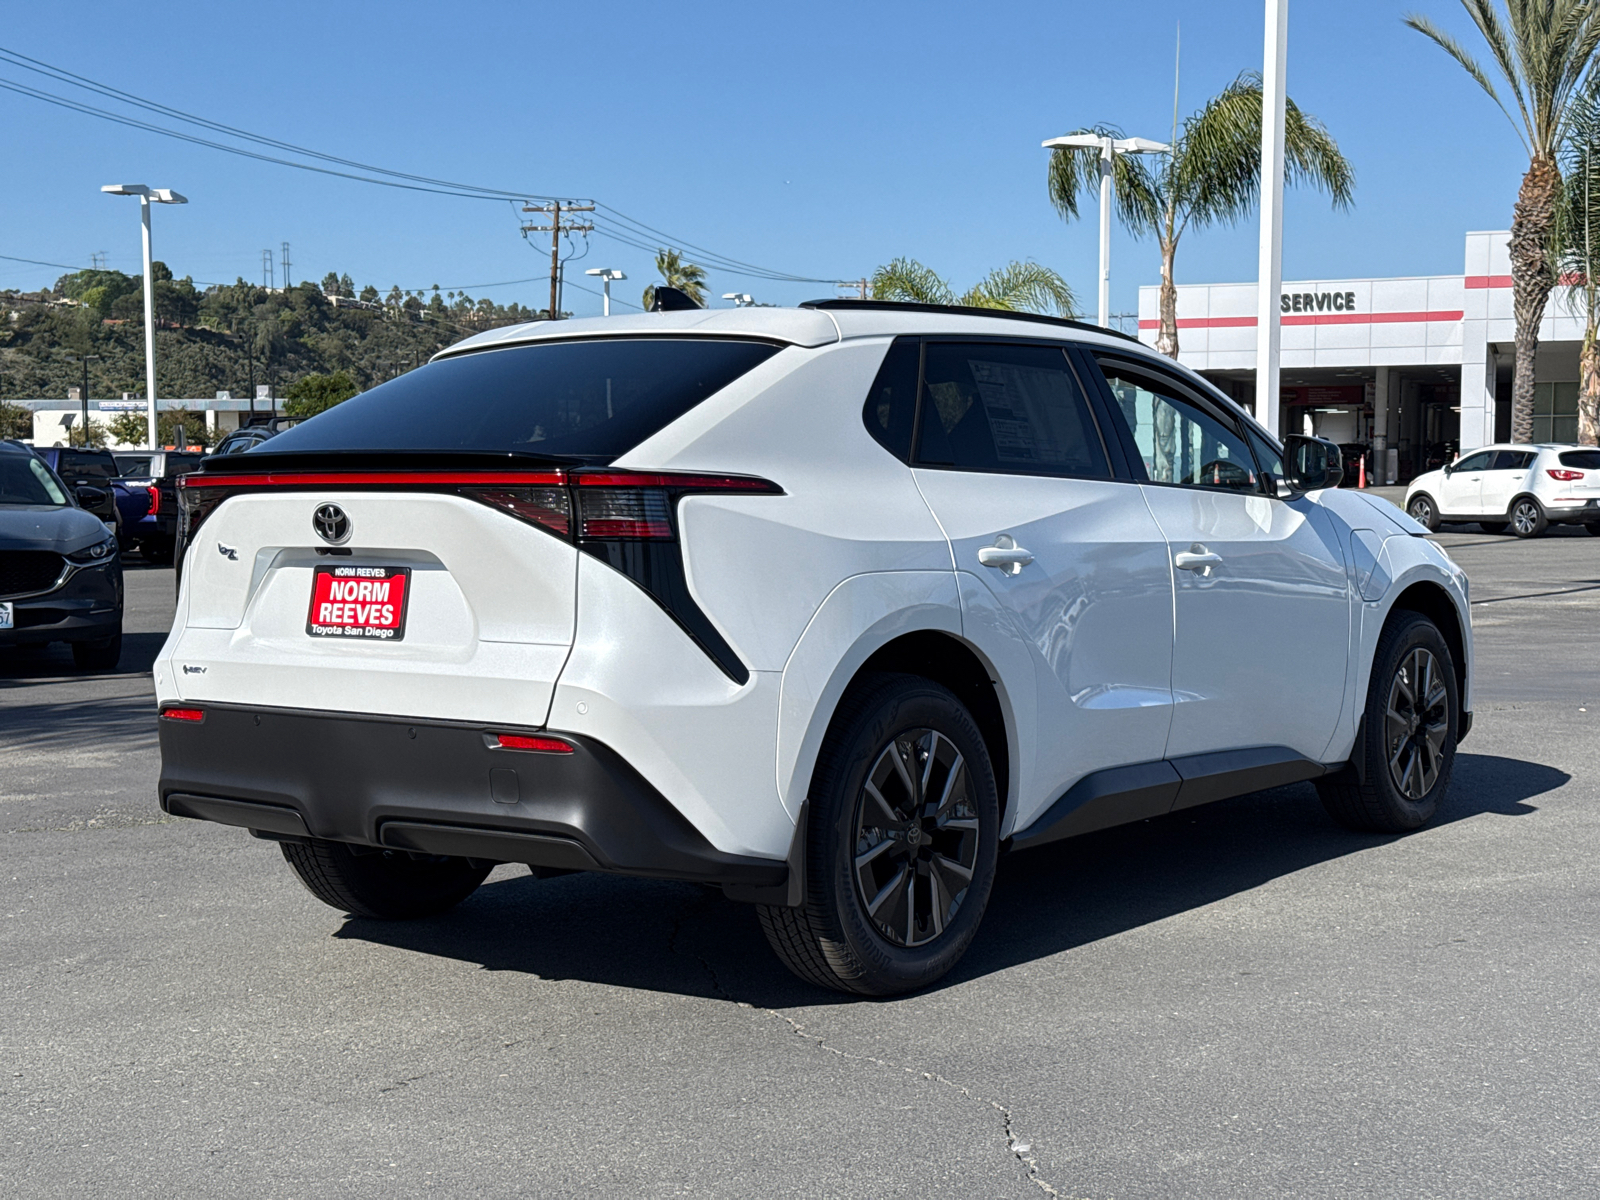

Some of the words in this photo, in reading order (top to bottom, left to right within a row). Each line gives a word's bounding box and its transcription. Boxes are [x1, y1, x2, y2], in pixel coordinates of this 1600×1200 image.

[1280, 291, 1356, 313] SERVICE
[334, 567, 356, 577] NORM
[356, 567, 386, 578] REEVES
[329, 580, 391, 602] NORM
[318, 602, 394, 625] REEVES
[311, 624, 343, 636] Toyota
[344, 625, 363, 636] San
[364, 627, 394, 639] Diego
[952, 707, 998, 814] BRIDGESTONE
[842, 861, 893, 972] BRIDGESTONE
